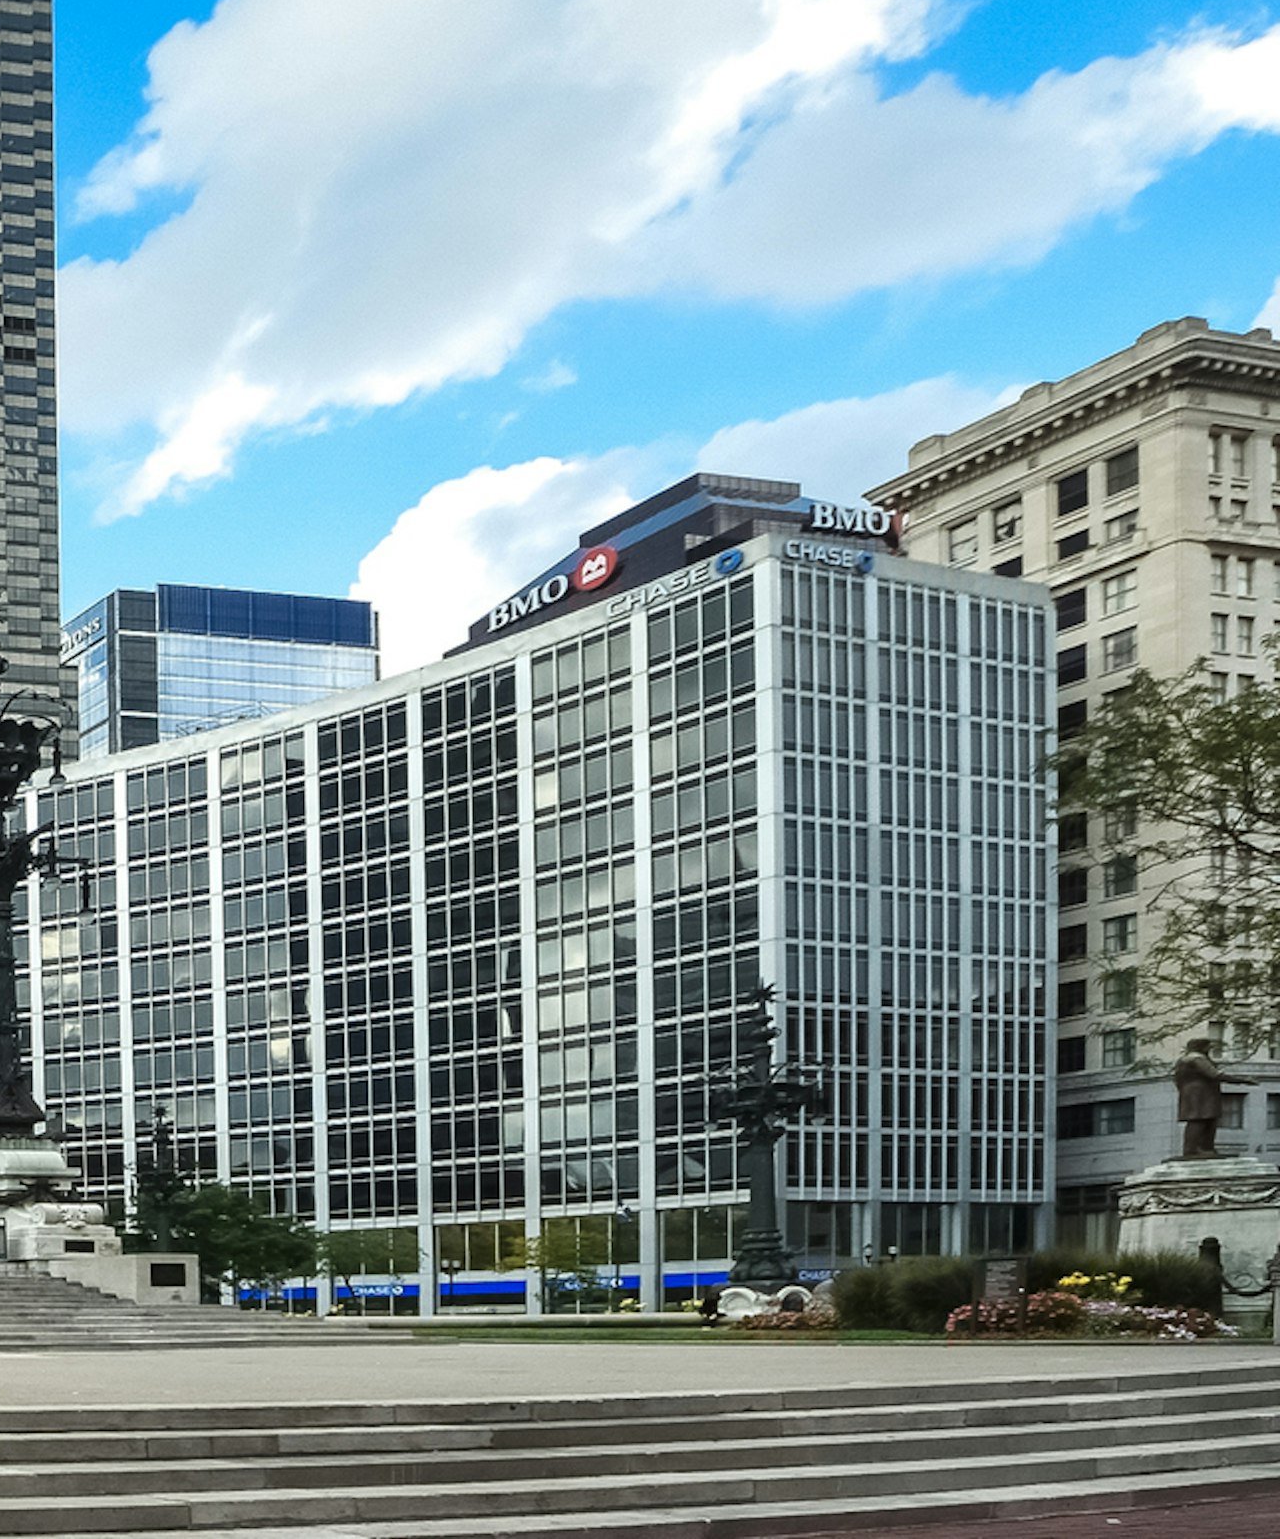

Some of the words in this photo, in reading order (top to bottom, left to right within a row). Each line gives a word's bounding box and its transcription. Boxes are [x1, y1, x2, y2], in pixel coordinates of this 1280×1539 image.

[811, 503, 891, 535] BMO
[786, 540, 854, 567] CHASE
[487, 574, 569, 632] BMO
[606, 562, 711, 617] CHASE
